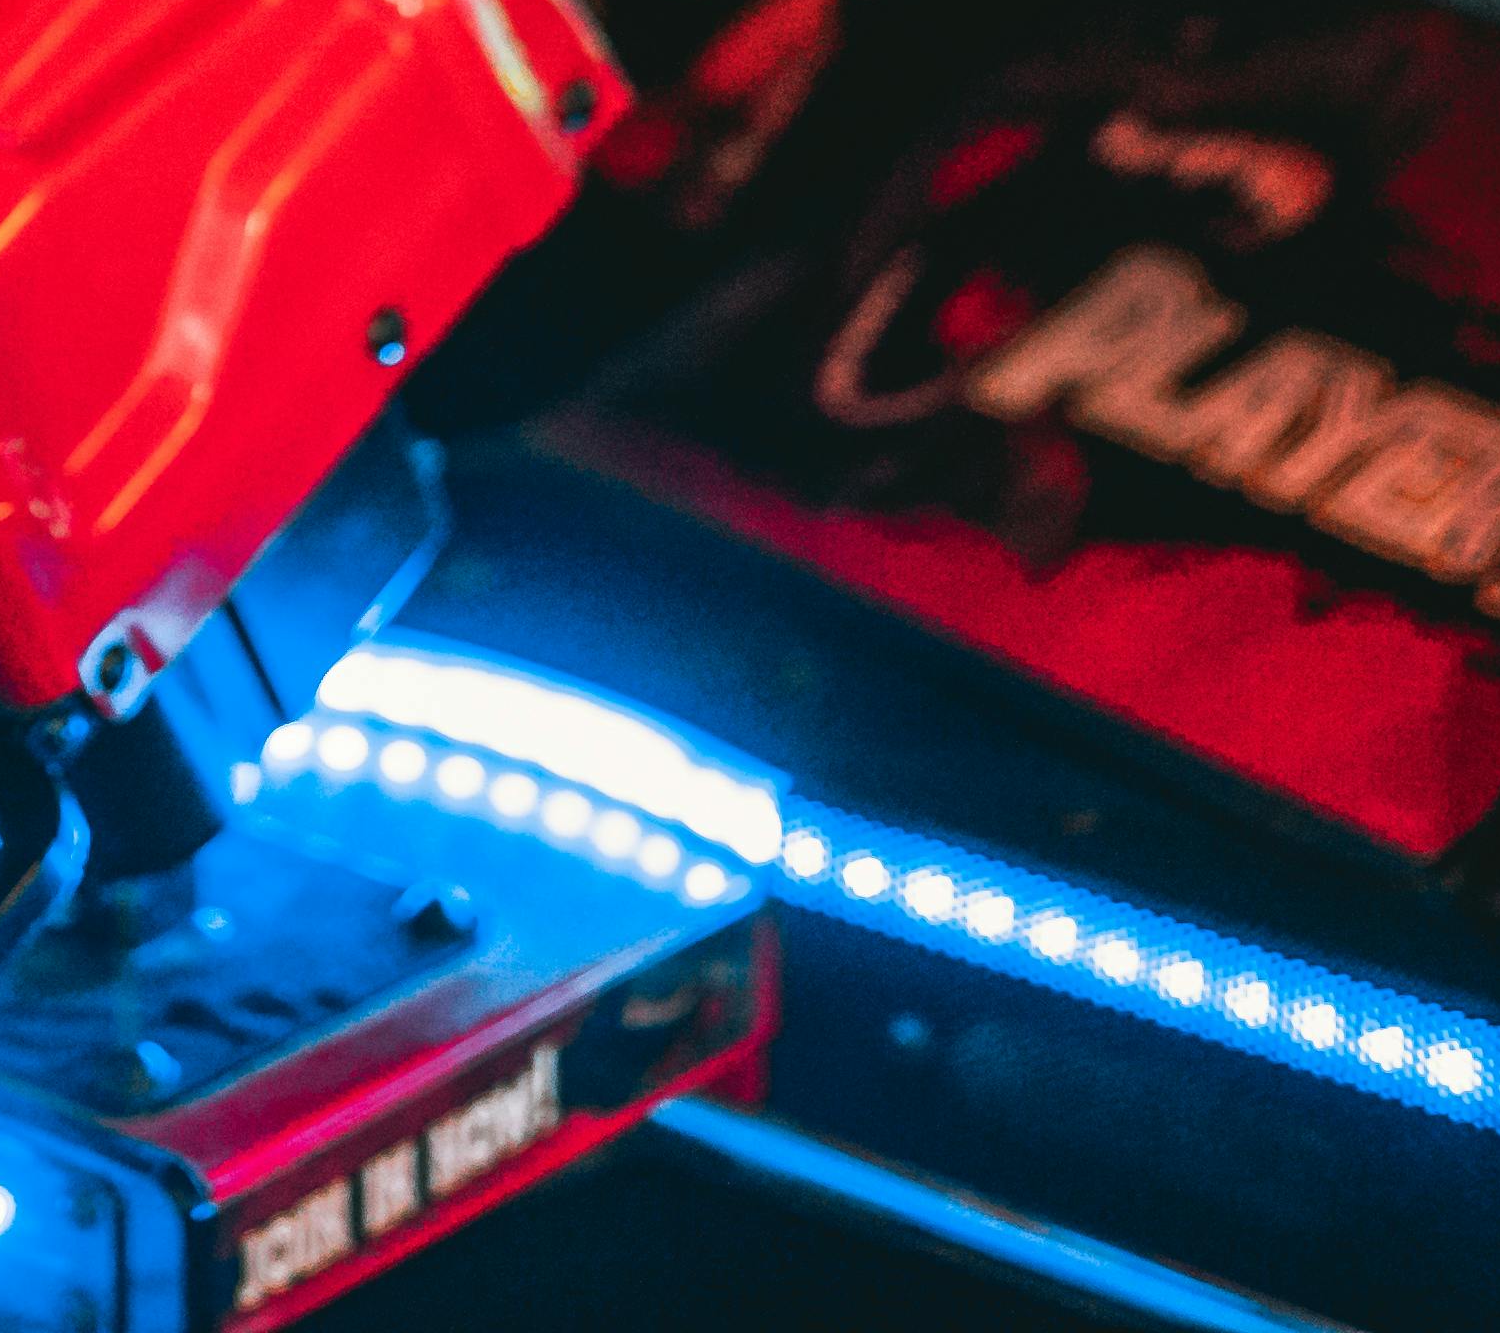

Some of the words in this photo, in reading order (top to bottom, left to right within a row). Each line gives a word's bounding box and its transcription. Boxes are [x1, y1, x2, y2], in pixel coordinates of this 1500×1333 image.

[233, 1178, 351, 1310] JOIN
[359, 1136, 422, 1235] IN
[426, 1043, 560, 1200] NOW!
